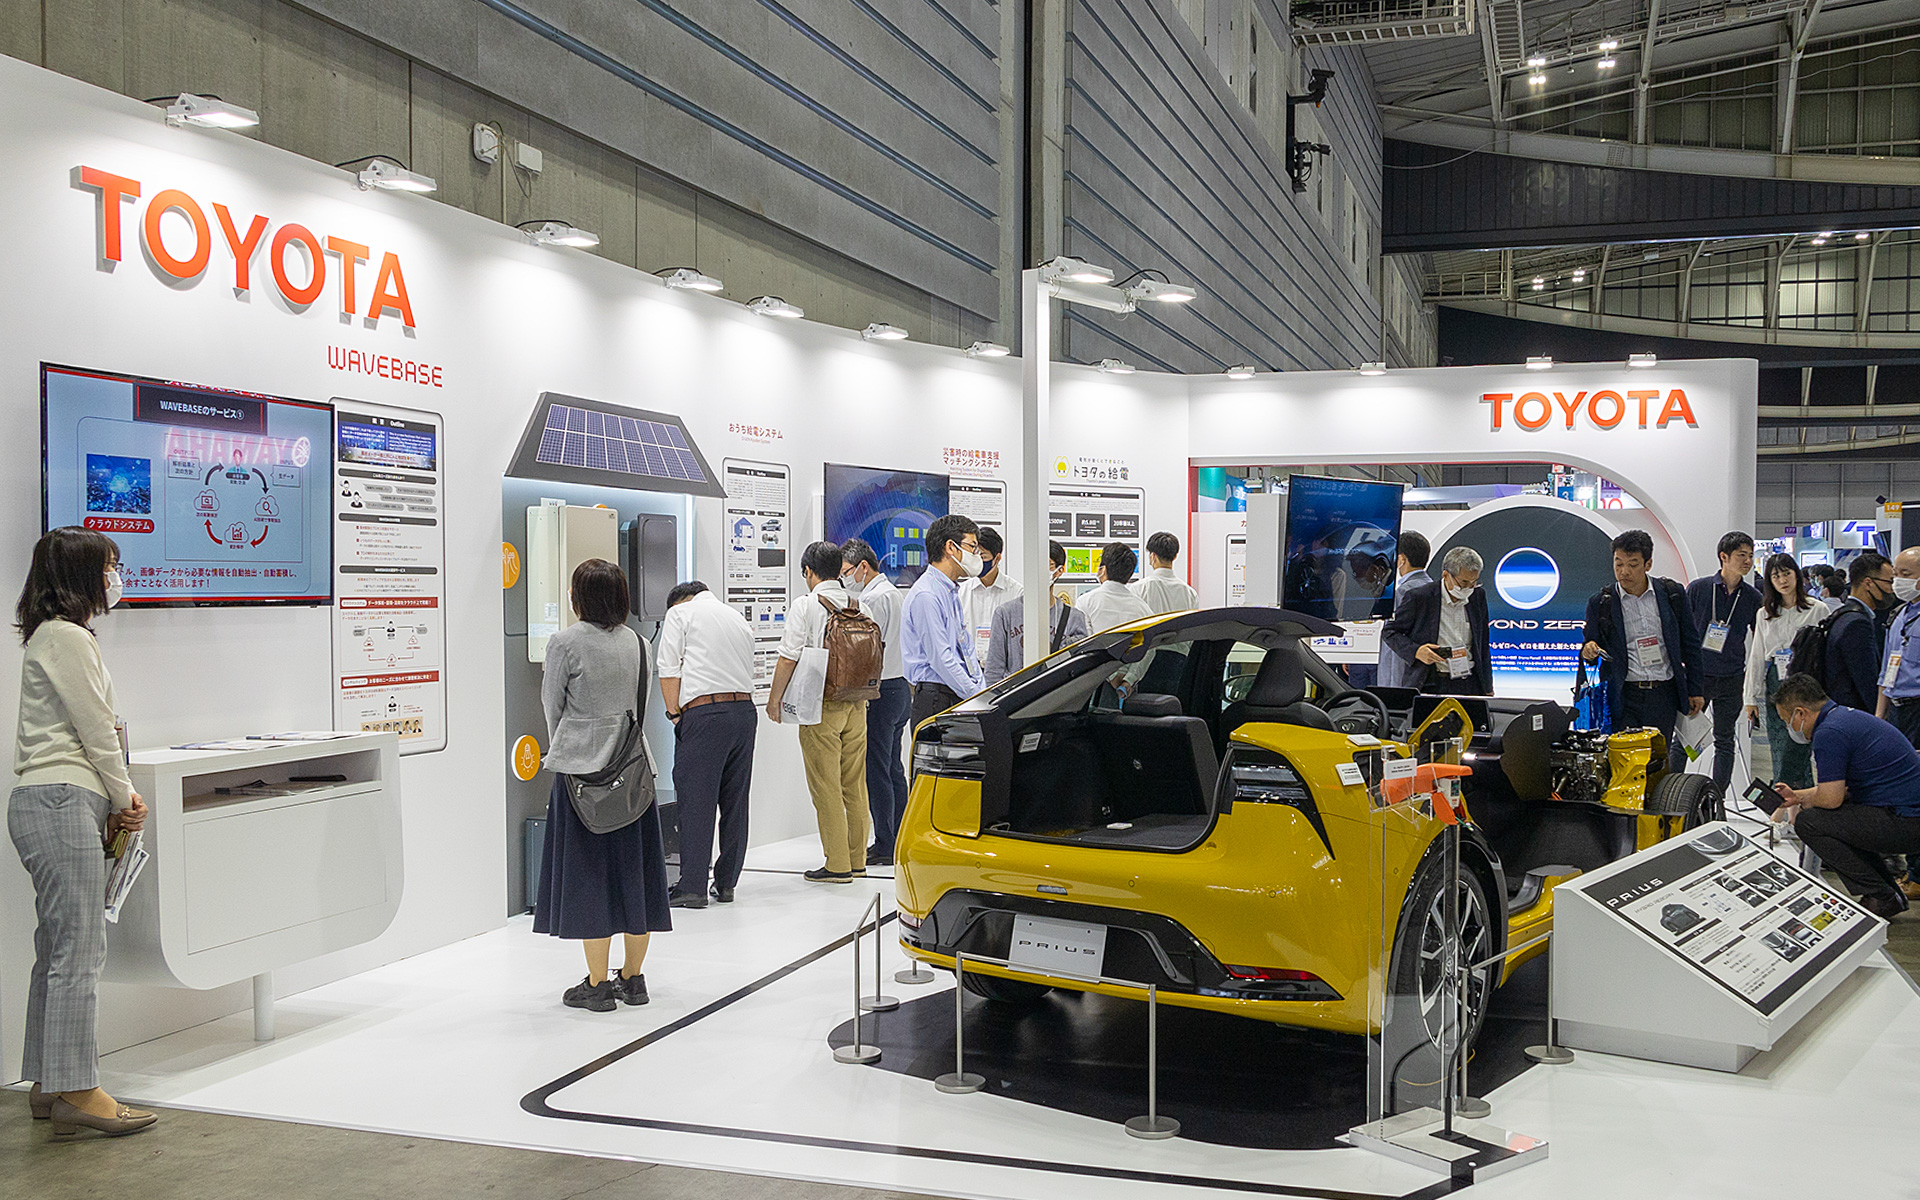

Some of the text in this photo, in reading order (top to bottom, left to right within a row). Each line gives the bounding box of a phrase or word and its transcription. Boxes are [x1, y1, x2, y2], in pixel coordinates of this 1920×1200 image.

[78, 164, 417, 330] TOYOTA
[327, 345, 443, 388] WAVEBASE
[1482, 388, 1698, 430] TOYOTA
[943, 457, 999, 468] マッチングシステム
[1073, 465, 1129, 481] トヨタの給電
[88, 519, 150, 531] クラウドシステム
[1543, 619, 1588, 630] ZER
[1606, 878, 1664, 908] PRIUS
[1019, 940, 1096, 955] PRIUS
